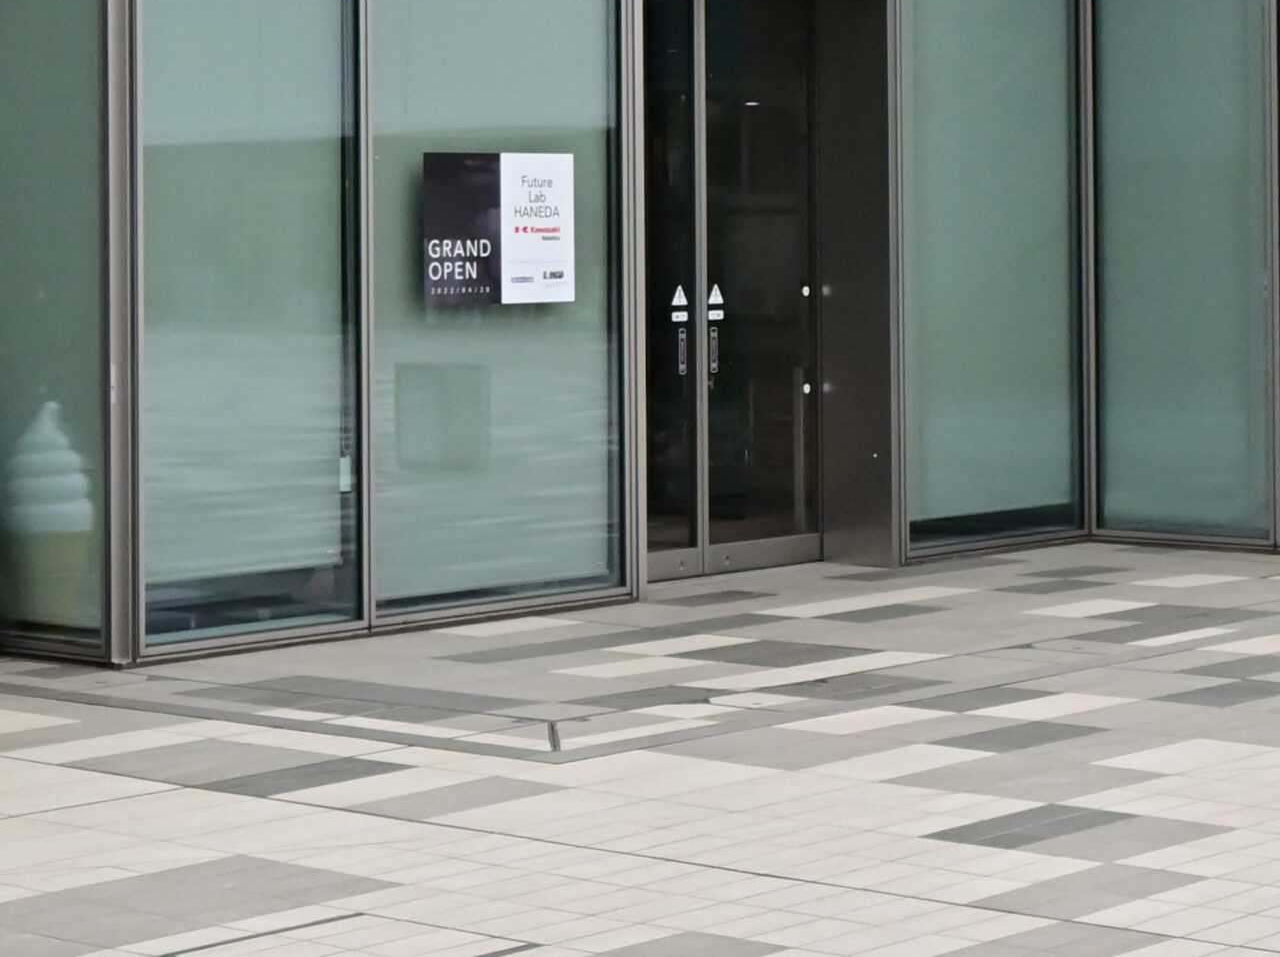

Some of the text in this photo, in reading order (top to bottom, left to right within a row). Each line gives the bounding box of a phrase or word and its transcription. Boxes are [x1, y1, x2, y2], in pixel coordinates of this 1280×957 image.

[521, 175, 553, 188] Future
[528, 191, 547, 204] Lab
[514, 205, 560, 219] HANEDA
[428, 239, 492, 258] GRAND
[428, 261, 478, 281] OPEN
